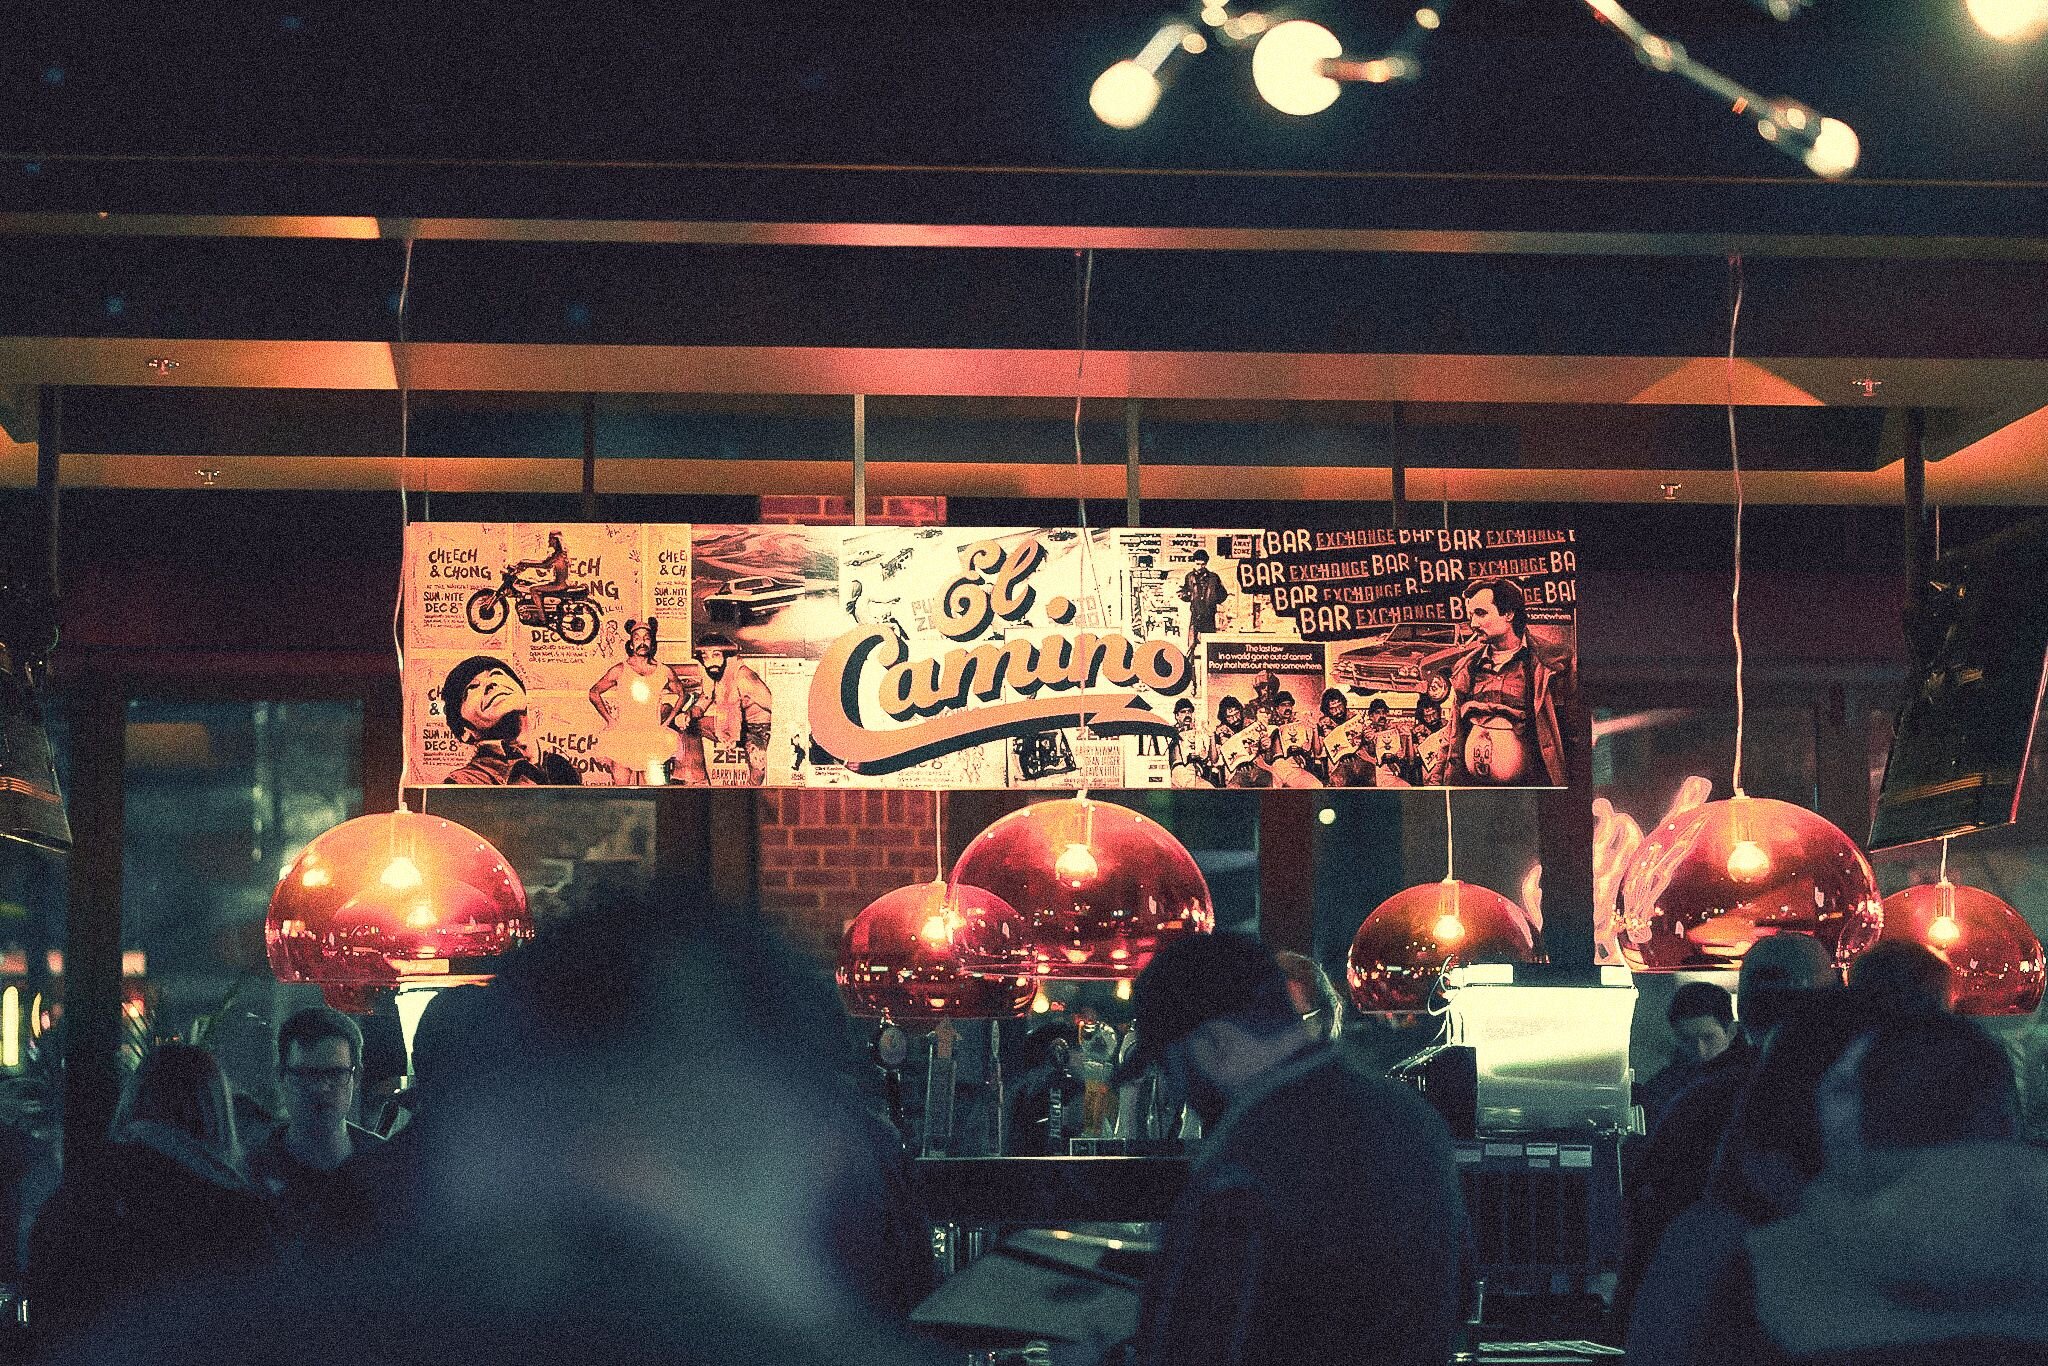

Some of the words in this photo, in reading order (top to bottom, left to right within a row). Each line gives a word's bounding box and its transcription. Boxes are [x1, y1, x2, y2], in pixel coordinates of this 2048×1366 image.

[1266, 529, 1312, 555] BAR
[1316, 529, 1396, 549] EXCHANGE
[428, 548, 478, 564] CHEECH
[658, 548, 687, 564] CHEE
[429, 564, 441, 578] &
[443, 565, 492, 580] CHONG
[659, 564, 669, 576] &
[1240, 561, 1286, 588] BAR
[1289, 560, 1369, 580] EXCHANGE
[1371, 552, 1410, 576] BAR
[1419, 558, 1465, 584] BAR
[1468, 557, 1547, 579] EXCHANGE
[936, 540, 1048, 641] El
[1274, 584, 1318, 611] BAR
[425, 602, 448, 613] DEC
[655, 597, 675, 606] DEC
[1300, 604, 1352, 634] BAR
[1355, 603, 1446, 626] EXCHANGE
[1245, 644, 1259, 652] The
[1231, 653, 1250, 661] world
[808, 597, 1194, 777] Camino
[429, 702, 440, 716] &
[424, 741, 448, 751] DEC
[713, 749, 749, 764] ZER
